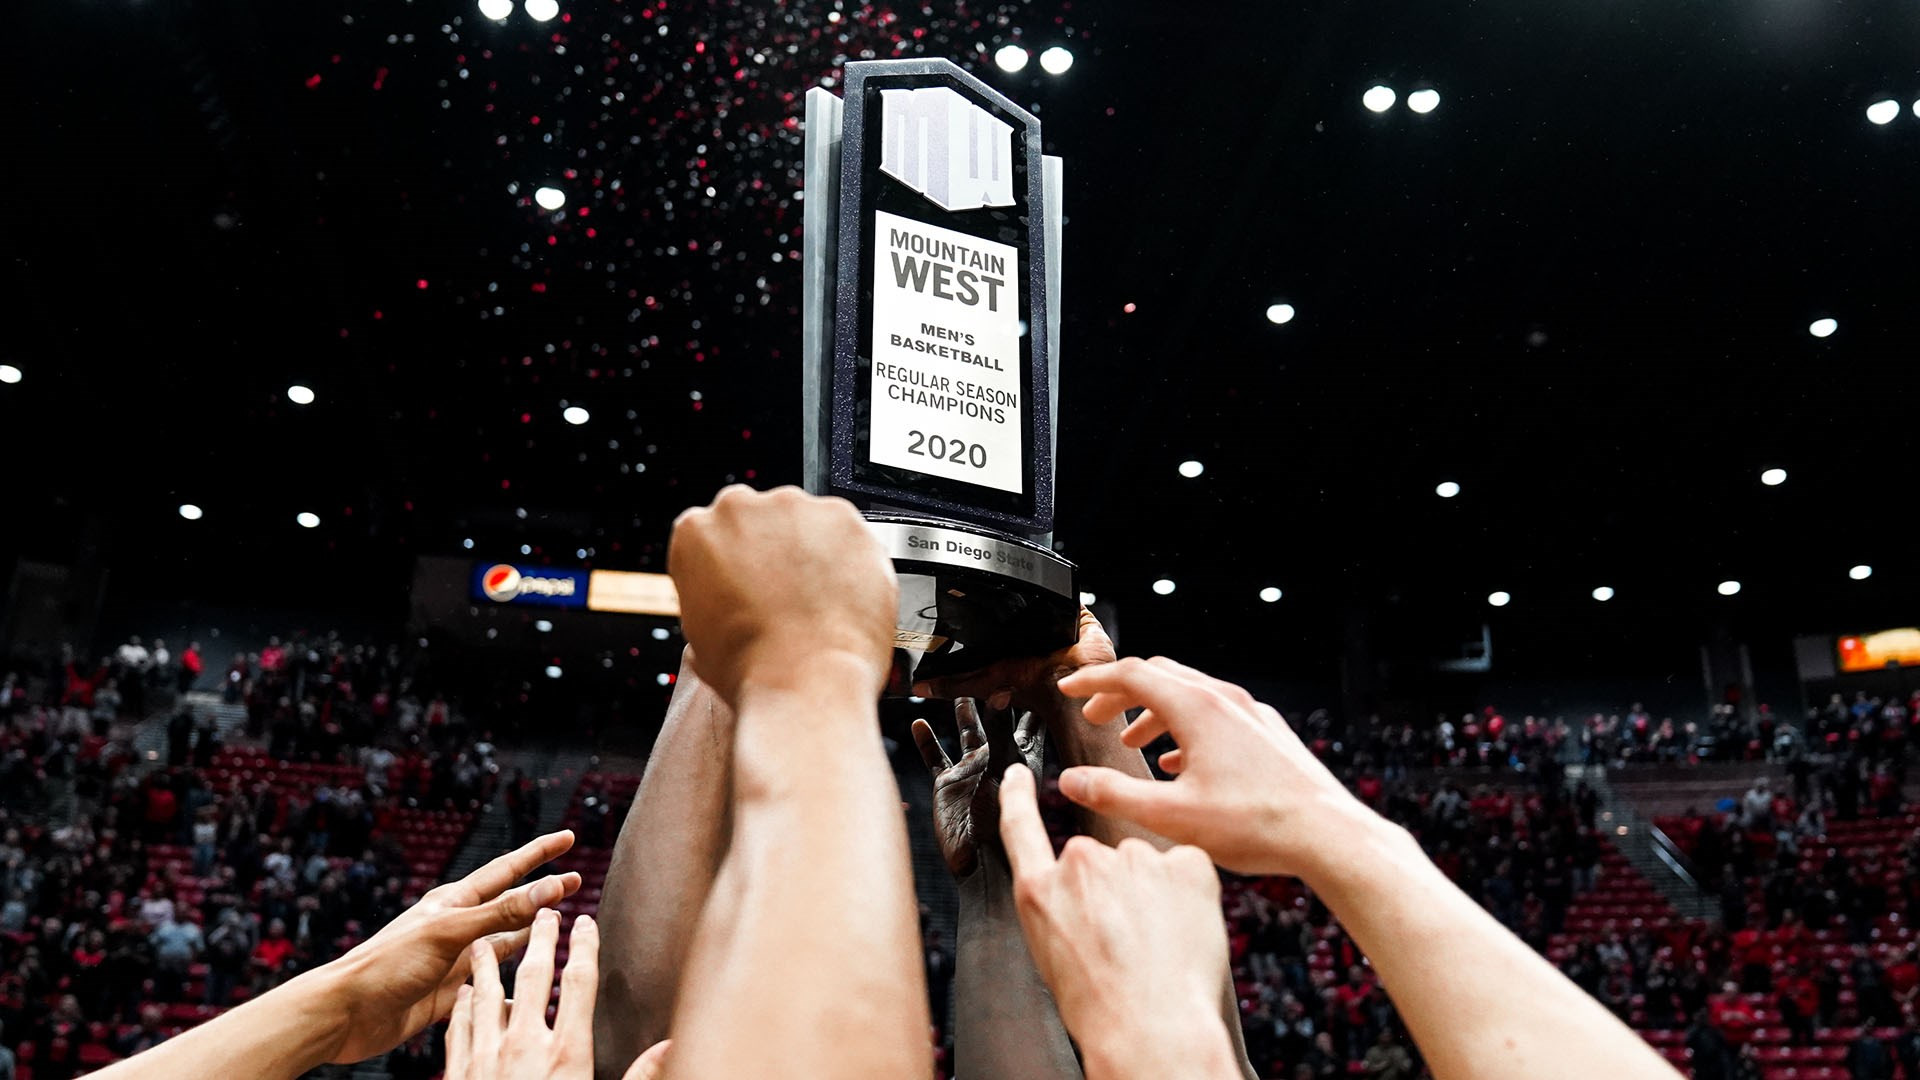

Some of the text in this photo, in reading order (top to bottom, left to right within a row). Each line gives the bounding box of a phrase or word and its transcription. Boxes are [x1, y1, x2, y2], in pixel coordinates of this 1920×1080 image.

[890, 228, 1005, 276] MOUNTAIN
[891, 251, 1005, 312] WEST
[890, 333, 1004, 372] BASKETBALL
[920, 322, 976, 346] MEN'S
[876, 361, 1017, 409] REGULAR SEASON
[888, 384, 1006, 424] CHAMPIONS
[907, 430, 987, 469] 2020
[907, 535, 1034, 571] San Diego State
